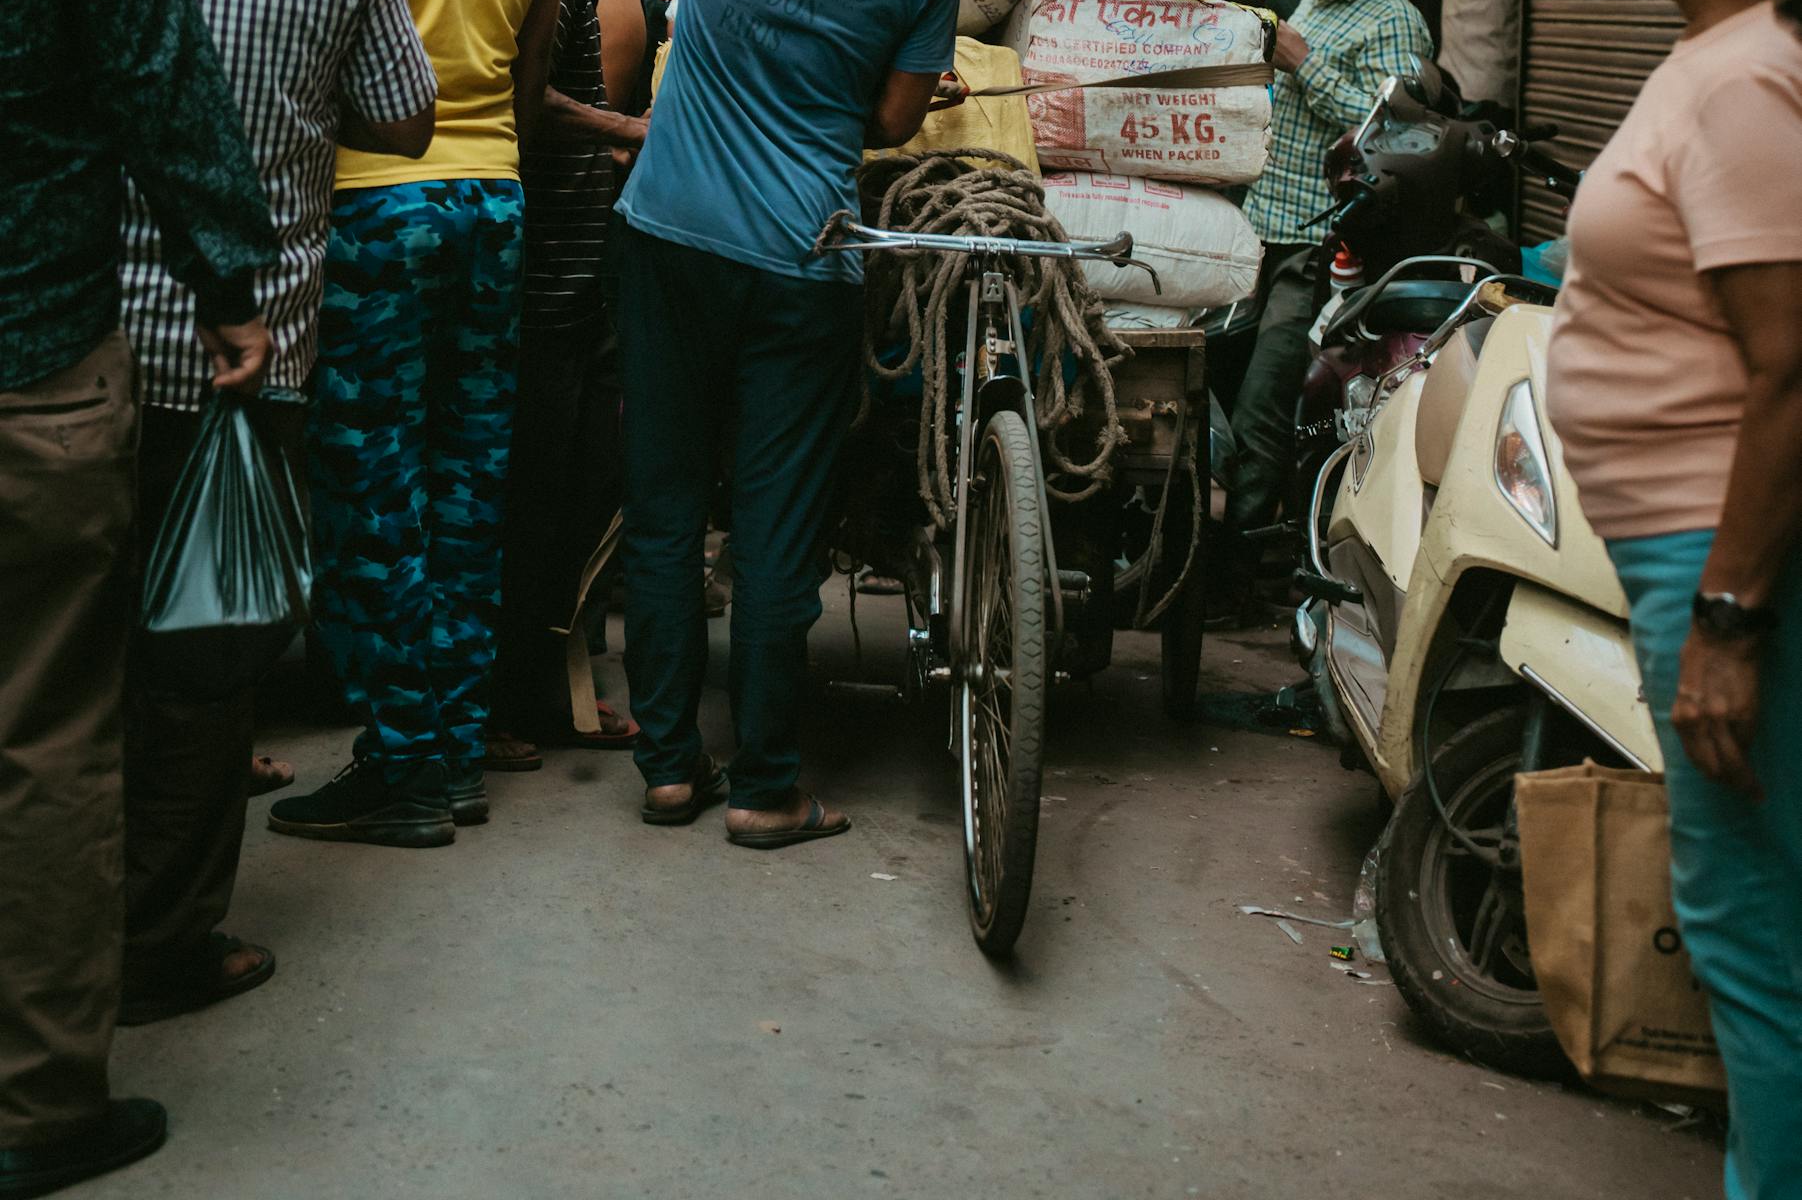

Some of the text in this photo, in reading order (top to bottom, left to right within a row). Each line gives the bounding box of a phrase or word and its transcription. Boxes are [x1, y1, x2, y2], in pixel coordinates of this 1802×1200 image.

[1064, 38, 1137, 55] CERTIFIED
[1143, 41, 1212, 57] COMPANY
[1122, 92, 1217, 106] NET WEIGHT
[1120, 112, 1227, 145] 45 KG.
[1121, 149, 1221, 161] WHEN PACKED
